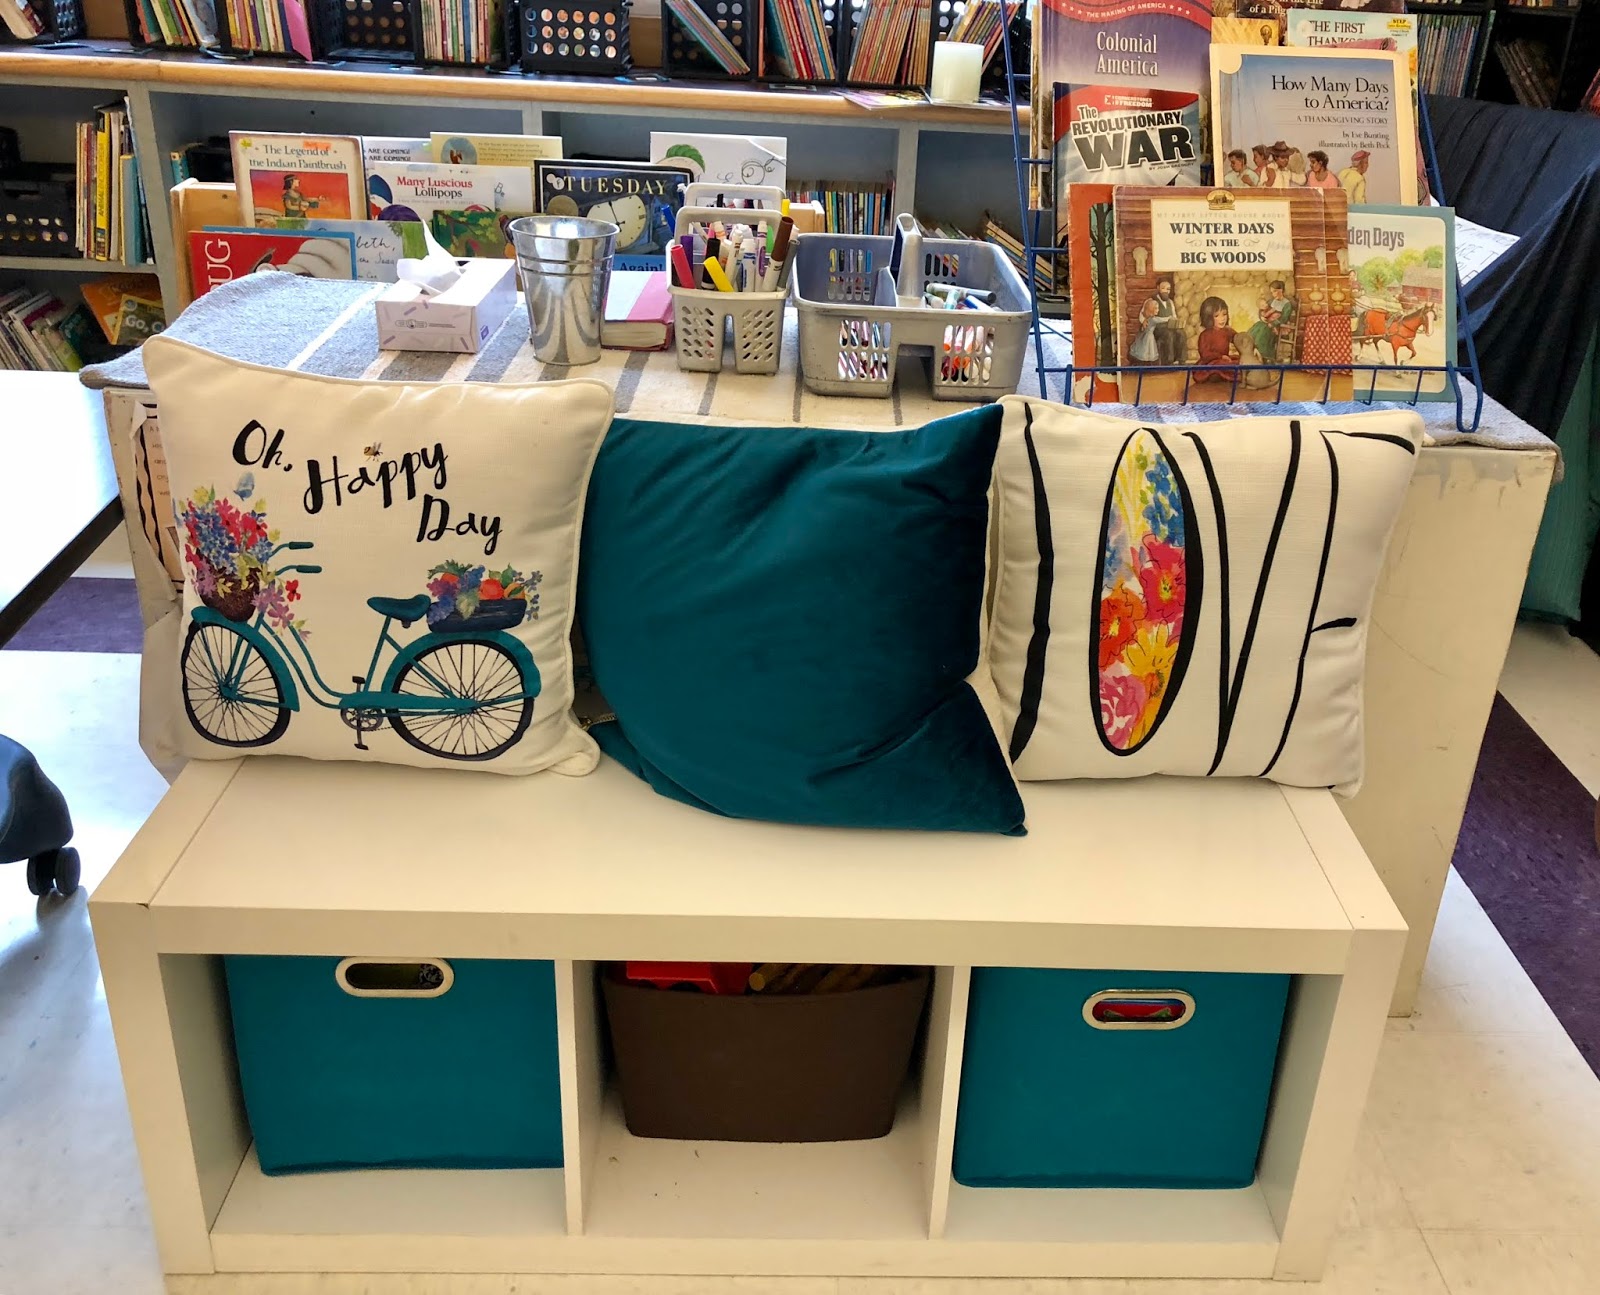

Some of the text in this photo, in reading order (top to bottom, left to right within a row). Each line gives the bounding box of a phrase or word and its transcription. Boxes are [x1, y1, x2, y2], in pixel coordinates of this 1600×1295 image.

[1101, 7, 1126, 18] MAKING
[1249, 5, 1260, 13] of
[1268, 5, 1286, 16] Pilg
[1334, 22, 1365, 34] FIRST
[1096, 31, 1157, 54] Colonial
[1096, 54, 1158, 76] America
[1272, 75, 1389, 98] How Many Days
[1304, 94, 1390, 110] to America?
[1078, 106, 1098, 120] The
[1072, 111, 1182, 136] REVOLUTIONARY
[1302, 116, 1365, 124] THANKSGIVING
[1364, 132, 1390, 140] Bunting
[263, 144, 330, 157] The Legend of
[1073, 126, 1195, 170] WAR
[1351, 141, 1358, 150] by
[266, 158, 296, 168] Indian
[298, 160, 347, 170] Paintbrush
[397, 176, 473, 188] Many Luscious
[564, 176, 668, 195] TUESDAY
[415, 187, 462, 199] Lollipops
[1170, 222, 1275, 234] WINTER DAYS
[1206, 239, 1240, 247] IN THE
[1373, 227, 1405, 251] Days
[1180, 252, 1266, 264] BIG WOODS
[204, 238, 233, 292] UG
[232, 419, 294, 472] Oh,
[303, 442, 449, 515] Happy
[416, 493, 503, 556] Day
